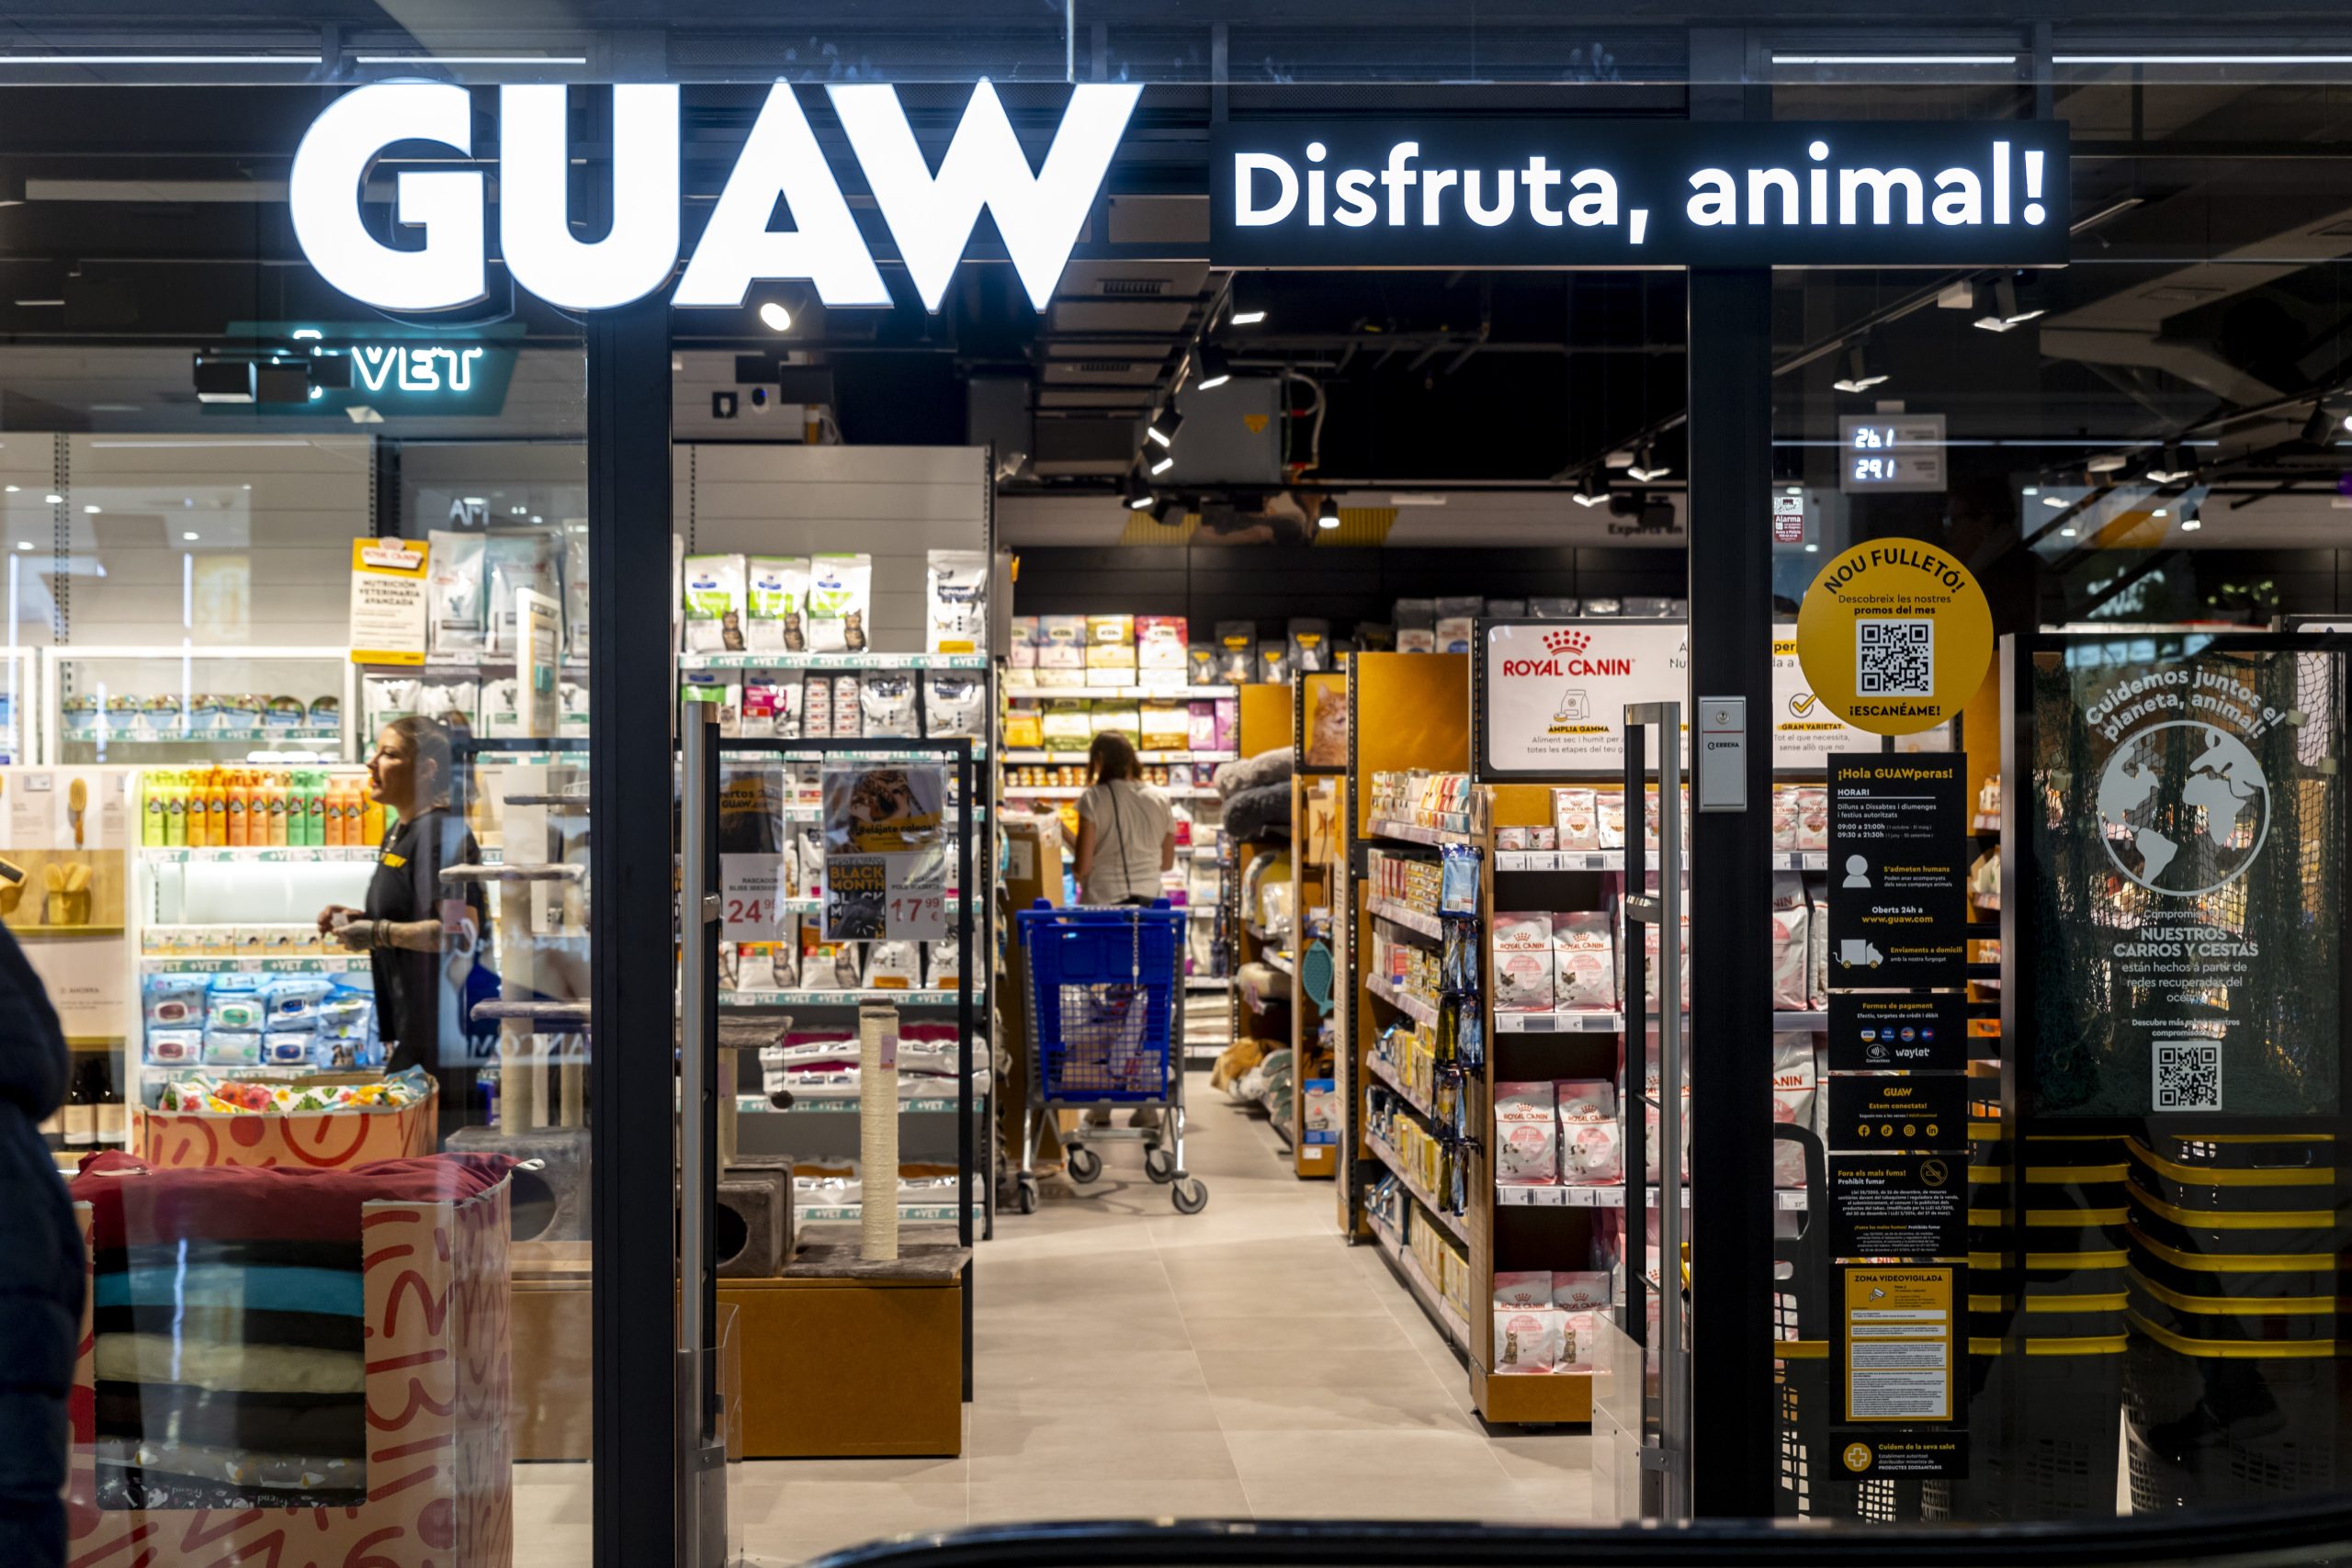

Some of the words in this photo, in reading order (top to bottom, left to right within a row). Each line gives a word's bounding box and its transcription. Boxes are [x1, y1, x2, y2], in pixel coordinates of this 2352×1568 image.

[289, 76, 1144, 314] GUAW
[1234, 141, 1649, 244] Disfruta,
[1686, 141, 2047, 226] animal!
[1824, 556, 1867, 594] NOU
[1871, 548, 1965, 593] FULLETÓ!
[1838, 593, 1894, 604] Descobreix
[1897, 593, 1911, 604] les
[1915, 595, 1951, 604] nostres
[1854, 607, 1893, 616] promos
[1896, 604, 1911, 615] del
[1503, 659, 1564, 677] ROYAL
[1568, 659, 1631, 676] CANIN
[2086, 669, 2188, 725] Cuidemos
[2192, 665, 2261, 708] juntos
[2263, 706, 2286, 728] el
[1849, 703, 1940, 716] ¡ESCANÉAME!
[2103, 693, 2184, 742] planeta,
[2191, 694, 2267, 739] animal!
[1549, 724, 1577, 733] ÀMPLIA
[1532, 735, 1561, 744] Aliment
[1582, 735, 1604, 743] humit
[1796, 735, 1811, 744] que
[1812, 734, 1850, 744] necessita,
[1549, 745, 1560, 753] les
[1561, 746, 1588, 754] etapes
[1803, 742, 1816, 751] allò
[1817, 745, 1833, 753] que
[1834, 744, 1847, 753] no
[1838, 767, 1871, 781] ¡Hola
[1874, 768, 1953, 781] GUAWperas!
[1838, 788, 1870, 796] HORARI
[1901, 803, 1937, 811] diumenges
[830, 866, 885, 878] BLACK
[830, 878, 886, 891] MONTH
[728, 899, 762, 923] 24
[890, 898, 922, 922] 17
[1871, 906, 1900, 914] Oberts
[1901, 906, 1917, 914] 24h
[1861, 917, 1933, 925] www.guaw.com
[2141, 928, 2227, 942] NUESTROS
[2113, 943, 2181, 957] CARROS
[2185, 944, 2195, 956] Y
[2198, 942, 2258, 957] CESTAS
[2121, 962, 2151, 972] están
[2154, 962, 2190, 972] hechos
[2202, 961, 2231, 974] partir
[2233, 962, 2247, 972] de
[2127, 976, 2155, 987] redes
[2158, 976, 2223, 989] recuperadas
[2226, 976, 2242, 987] del
[2132, 1018, 2166, 1026] Descubre
[2168, 1018, 2184, 1026] más
[1883, 1088, 1913, 1097] GUAW
